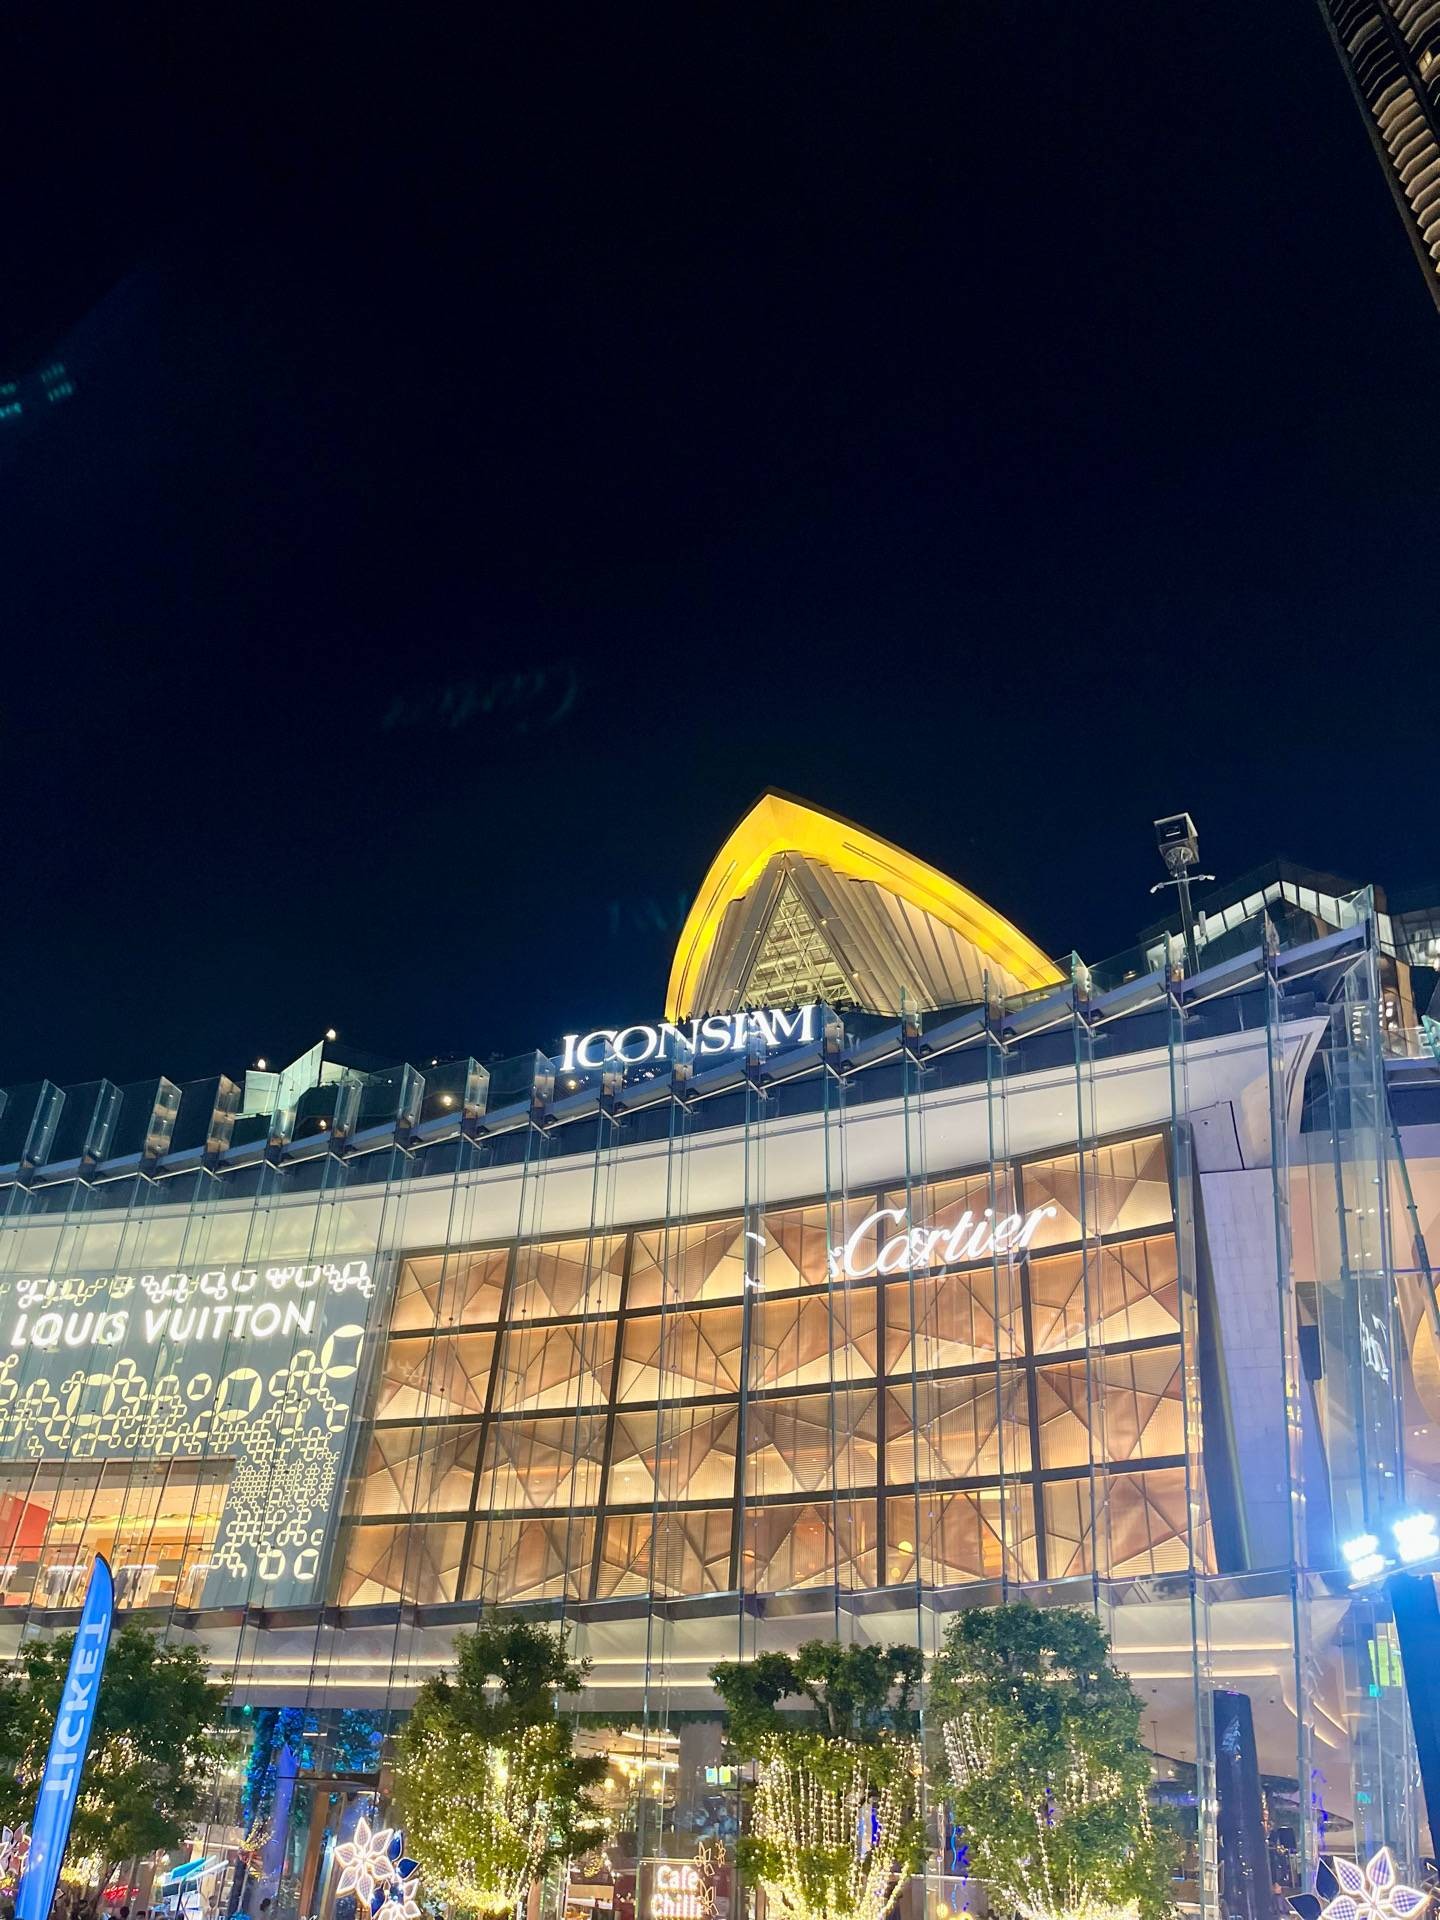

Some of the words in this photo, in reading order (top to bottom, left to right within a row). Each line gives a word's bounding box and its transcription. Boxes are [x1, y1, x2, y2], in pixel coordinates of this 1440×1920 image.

[559, 1004, 818, 1072] ICONSIAM
[843, 1207, 1058, 1278] Cartier
[10, 1310, 130, 1347] LOUIS
[144, 1300, 316, 1344] VUITTON
[45, 1612, 107, 1802] TICKET
